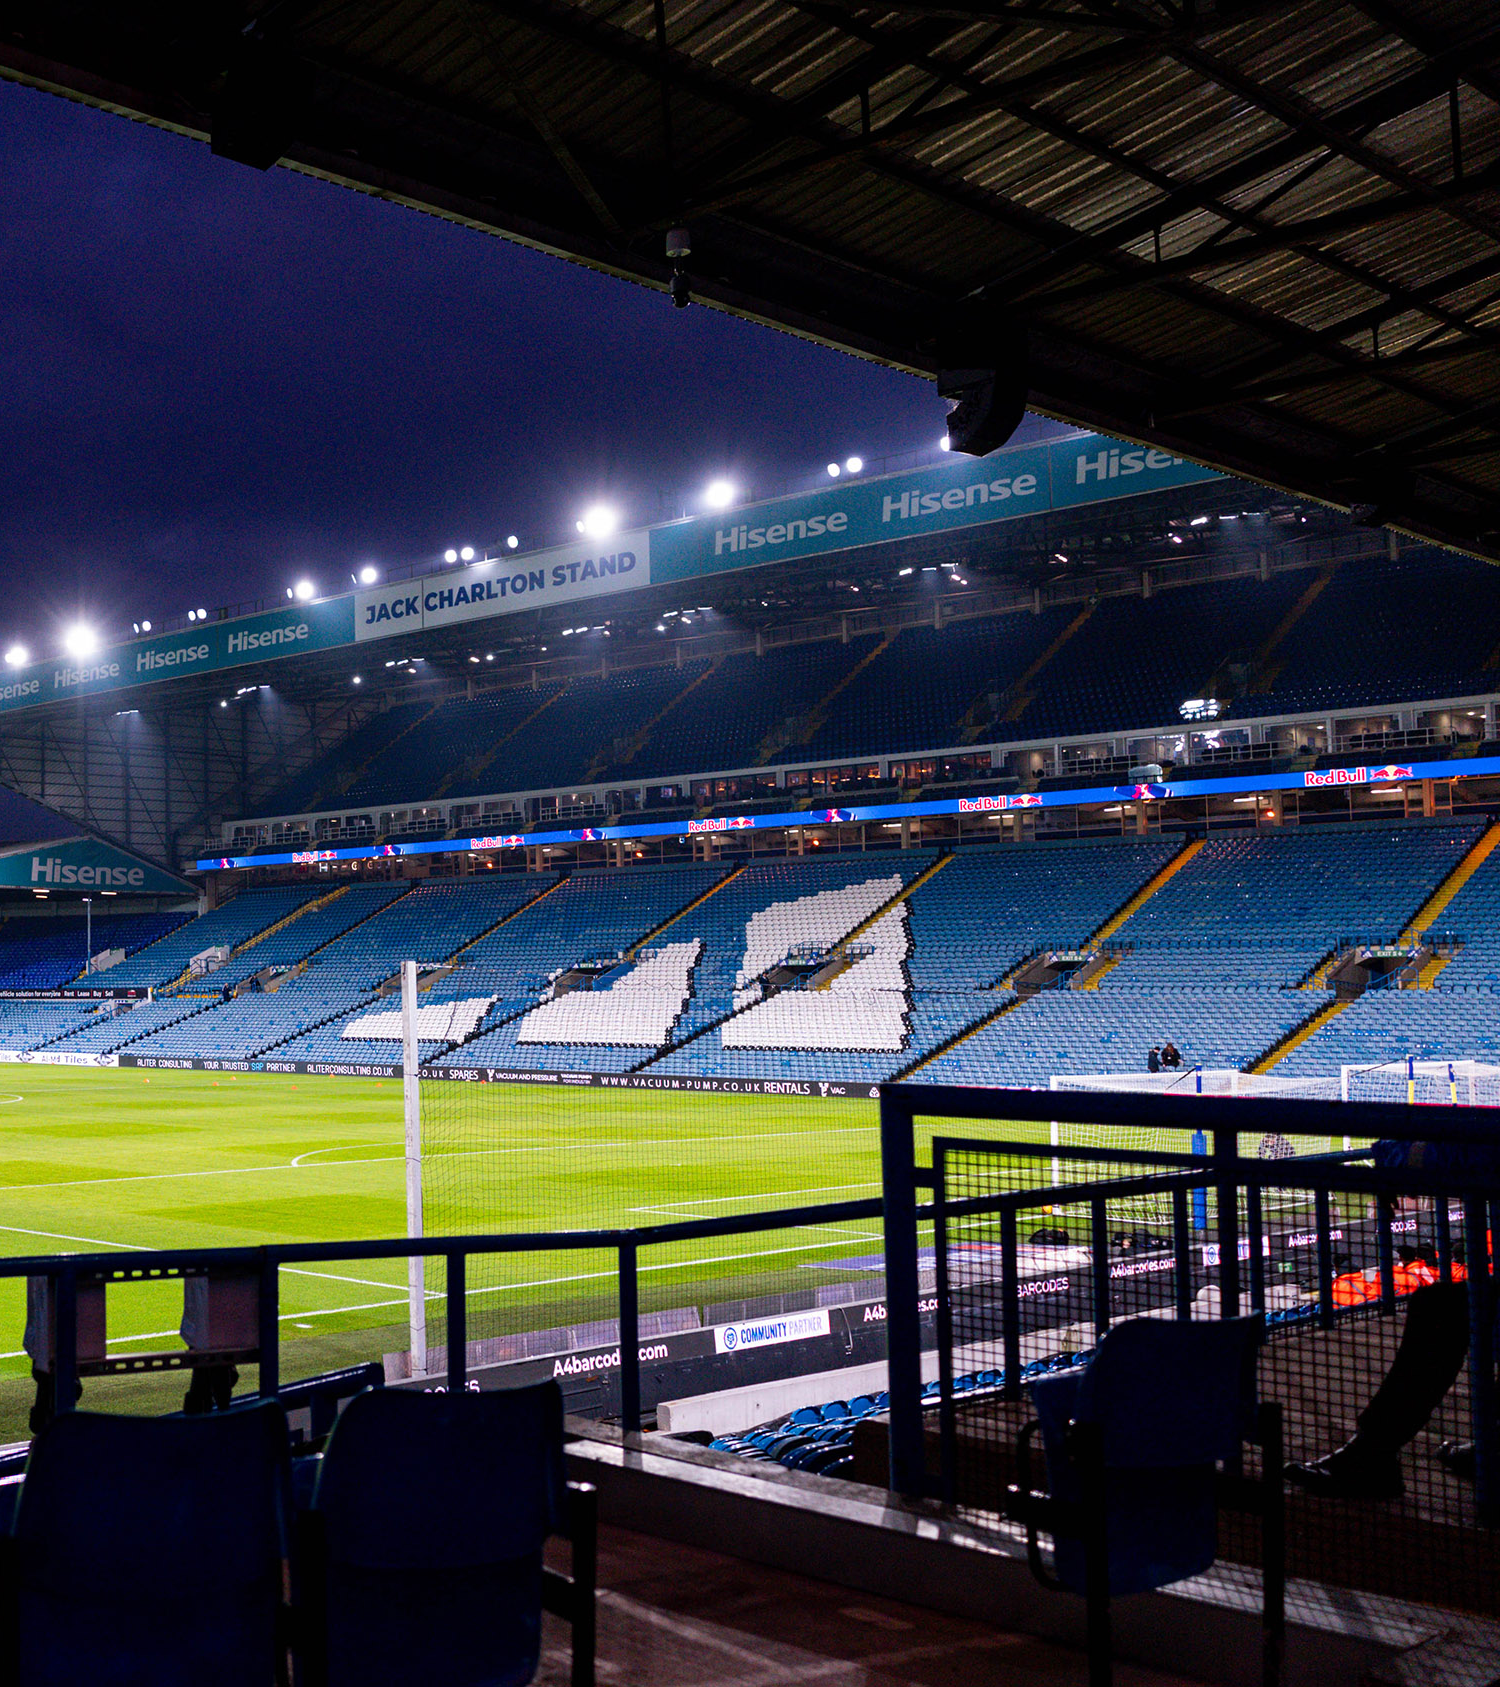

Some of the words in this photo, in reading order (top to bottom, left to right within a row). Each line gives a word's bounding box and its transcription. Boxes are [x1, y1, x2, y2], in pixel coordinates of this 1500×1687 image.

[882, 474, 1036, 522] Hisense
[714, 512, 847, 554] Hisense
[365, 596, 419, 624] JACK
[424, 569, 545, 612] CHARLTON
[552, 552, 636, 586] STAND
[228, 623, 308, 653] Hisense
[136, 643, 209, 672] Hisense
[54, 663, 120, 688] Hisense
[31, 856, 145, 886] Hisense
[64, 1056, 88, 1065] Tiles
[137, 1058, 157, 1067] ALITER
[158, 1059, 193, 1069] CONSULTING
[203, 1061, 219, 1070] YOUR
[221, 1061, 249, 1071] TRUSTED
[251, 1062, 264, 1071] SAP
[266, 1063, 296, 1072] PARTNER
[307, 1064, 394, 1076] ALITERCONSULTING.CO.UK
[449, 1069, 479, 1080] SPARES
[495, 1072, 518, 1080] VACUUM
[532, 1074, 558, 1082] PRESSURE
[601, 1076, 760, 1092] WWW.VACUUM-PUMP.CO.UK
[764, 1081, 810, 1095] RENTALS
[830, 1086, 846, 1095] VAC
[740, 1321, 788, 1344] COMMUNITY
[788, 1316, 822, 1337] PARTNER
[553, 1343, 669, 1378] A4barcod.com
